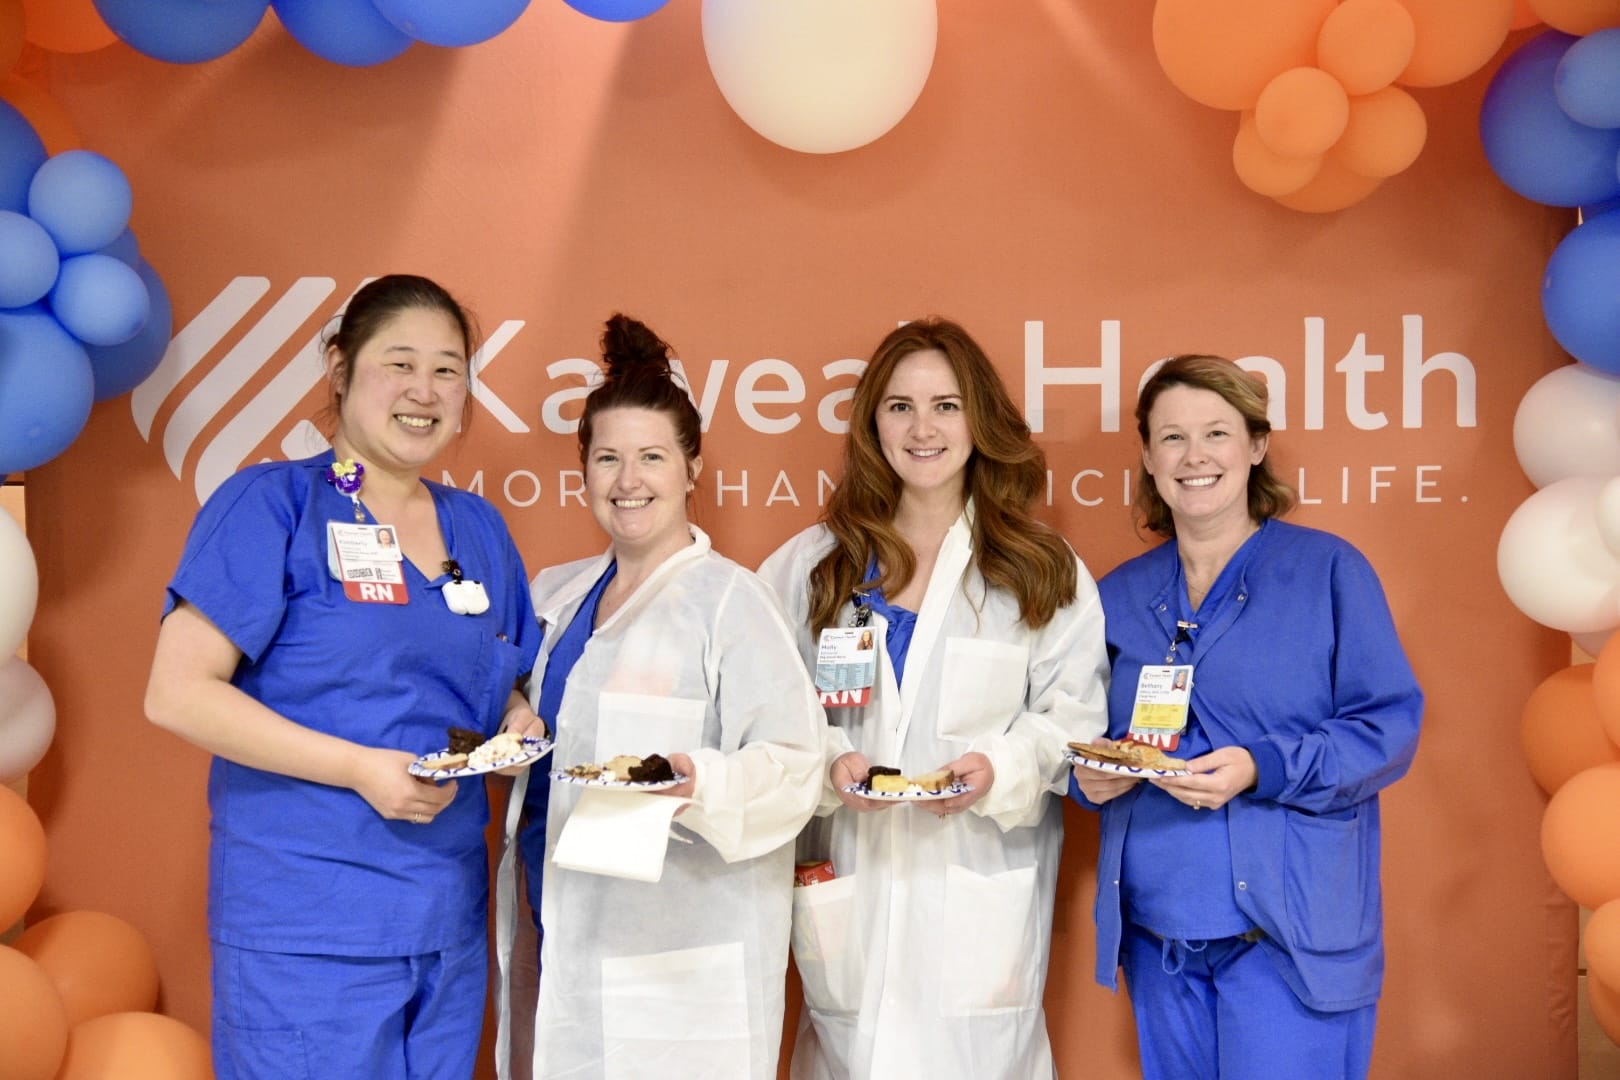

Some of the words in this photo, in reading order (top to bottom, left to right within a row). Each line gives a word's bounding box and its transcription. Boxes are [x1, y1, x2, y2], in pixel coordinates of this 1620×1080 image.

[441, 468, 588, 507] MOR
[1299, 465, 1468, 504] LIFE.
[359, 583, 395, 602] RN
